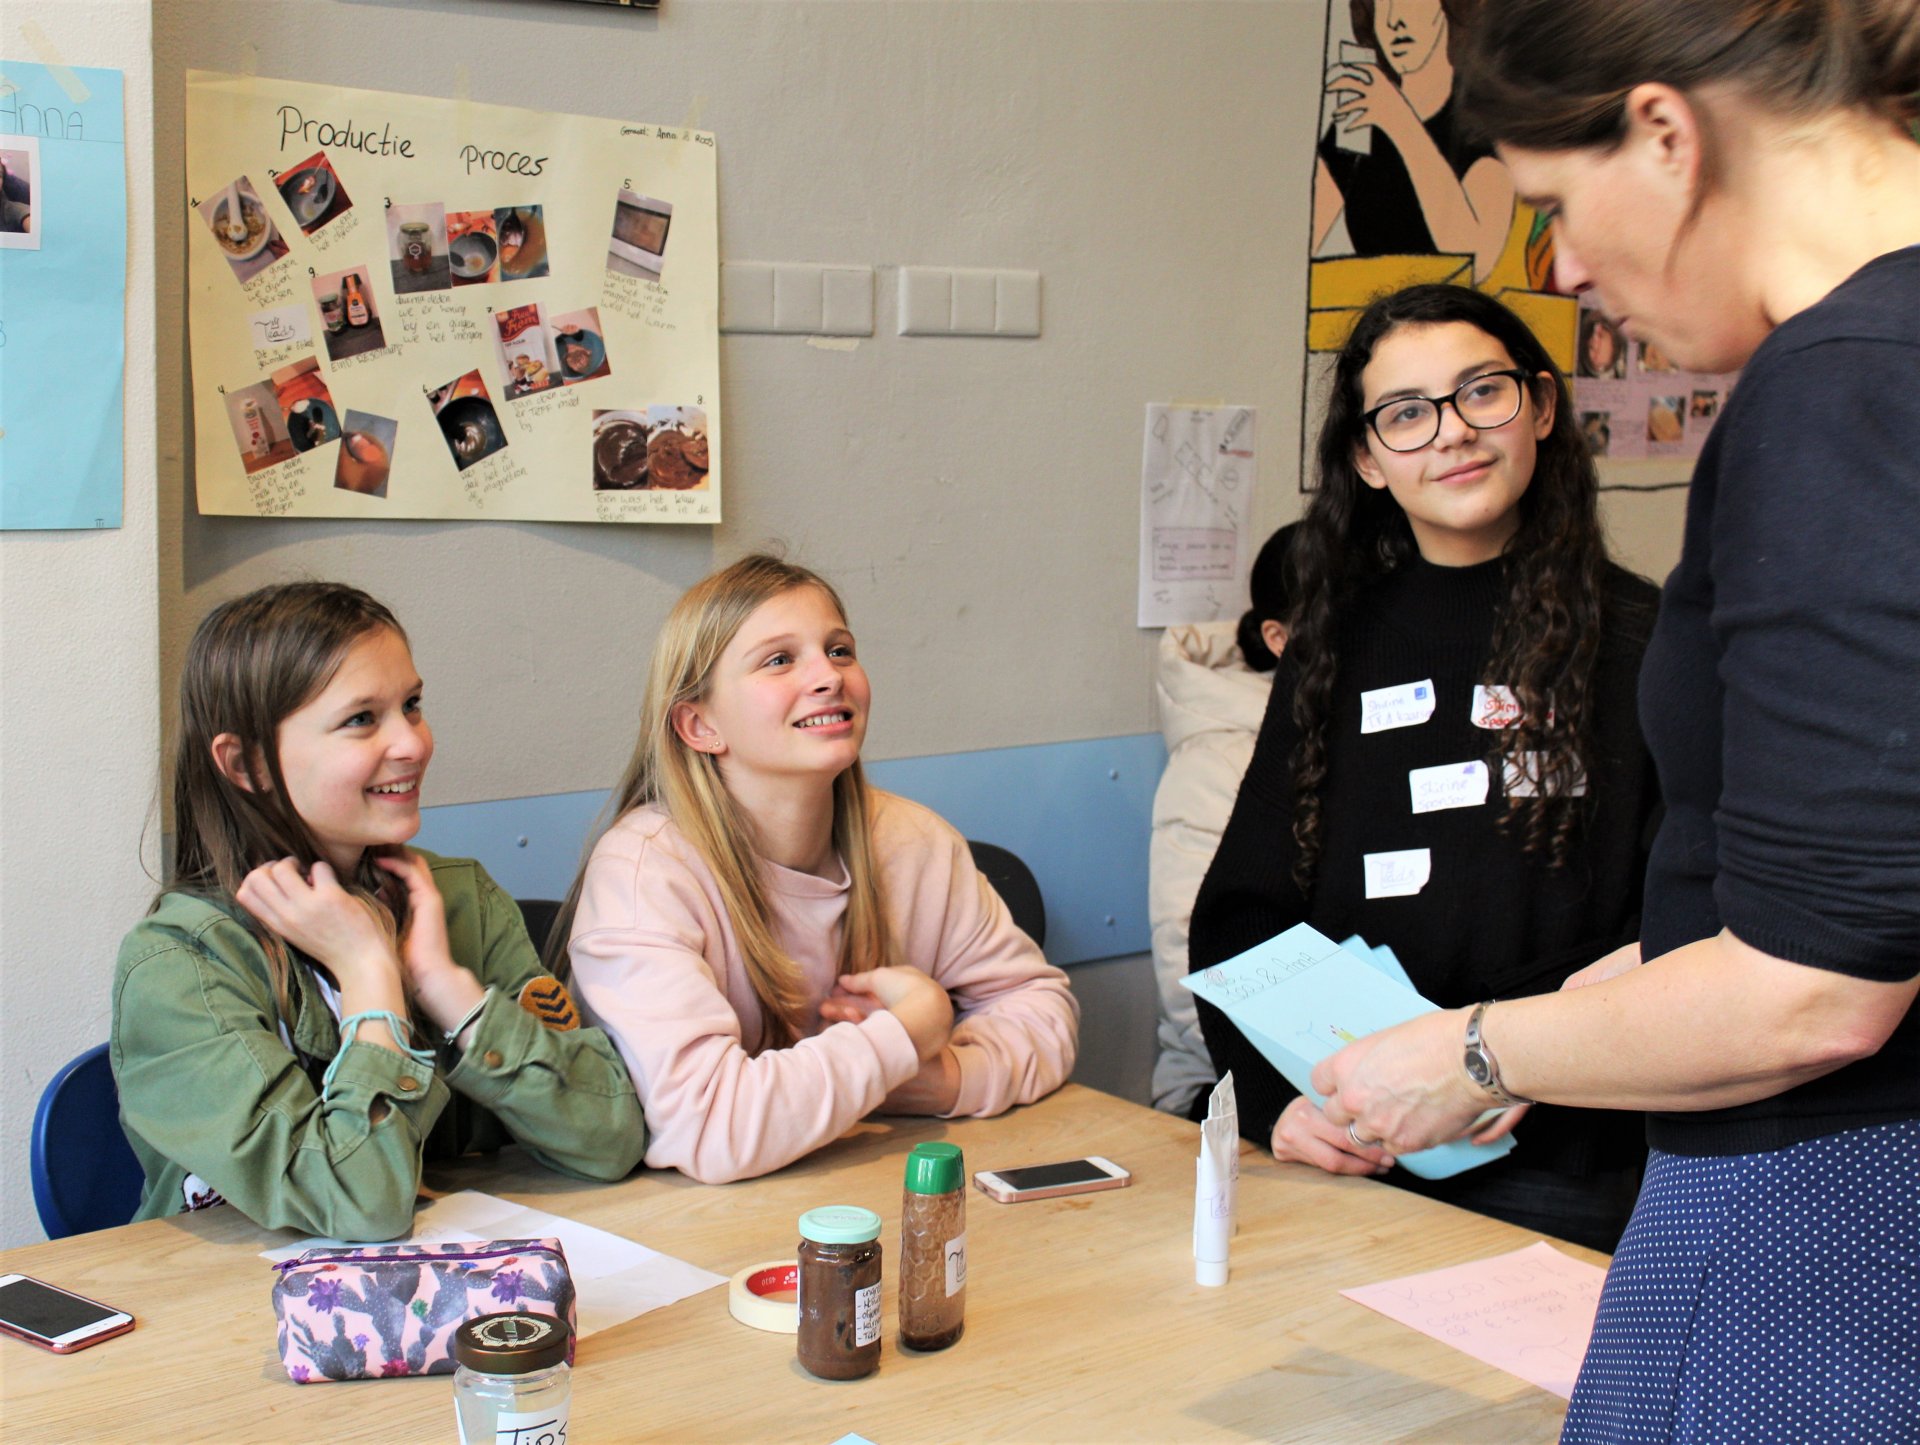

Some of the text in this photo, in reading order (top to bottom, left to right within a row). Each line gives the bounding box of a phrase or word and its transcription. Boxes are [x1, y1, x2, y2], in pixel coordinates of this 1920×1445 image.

[276, 105, 415, 158] Productie
[399, 307, 414, 317] we
[421, 305, 432, 315] er
[403, 335, 420, 343] we
[429, 332, 446, 342] het
